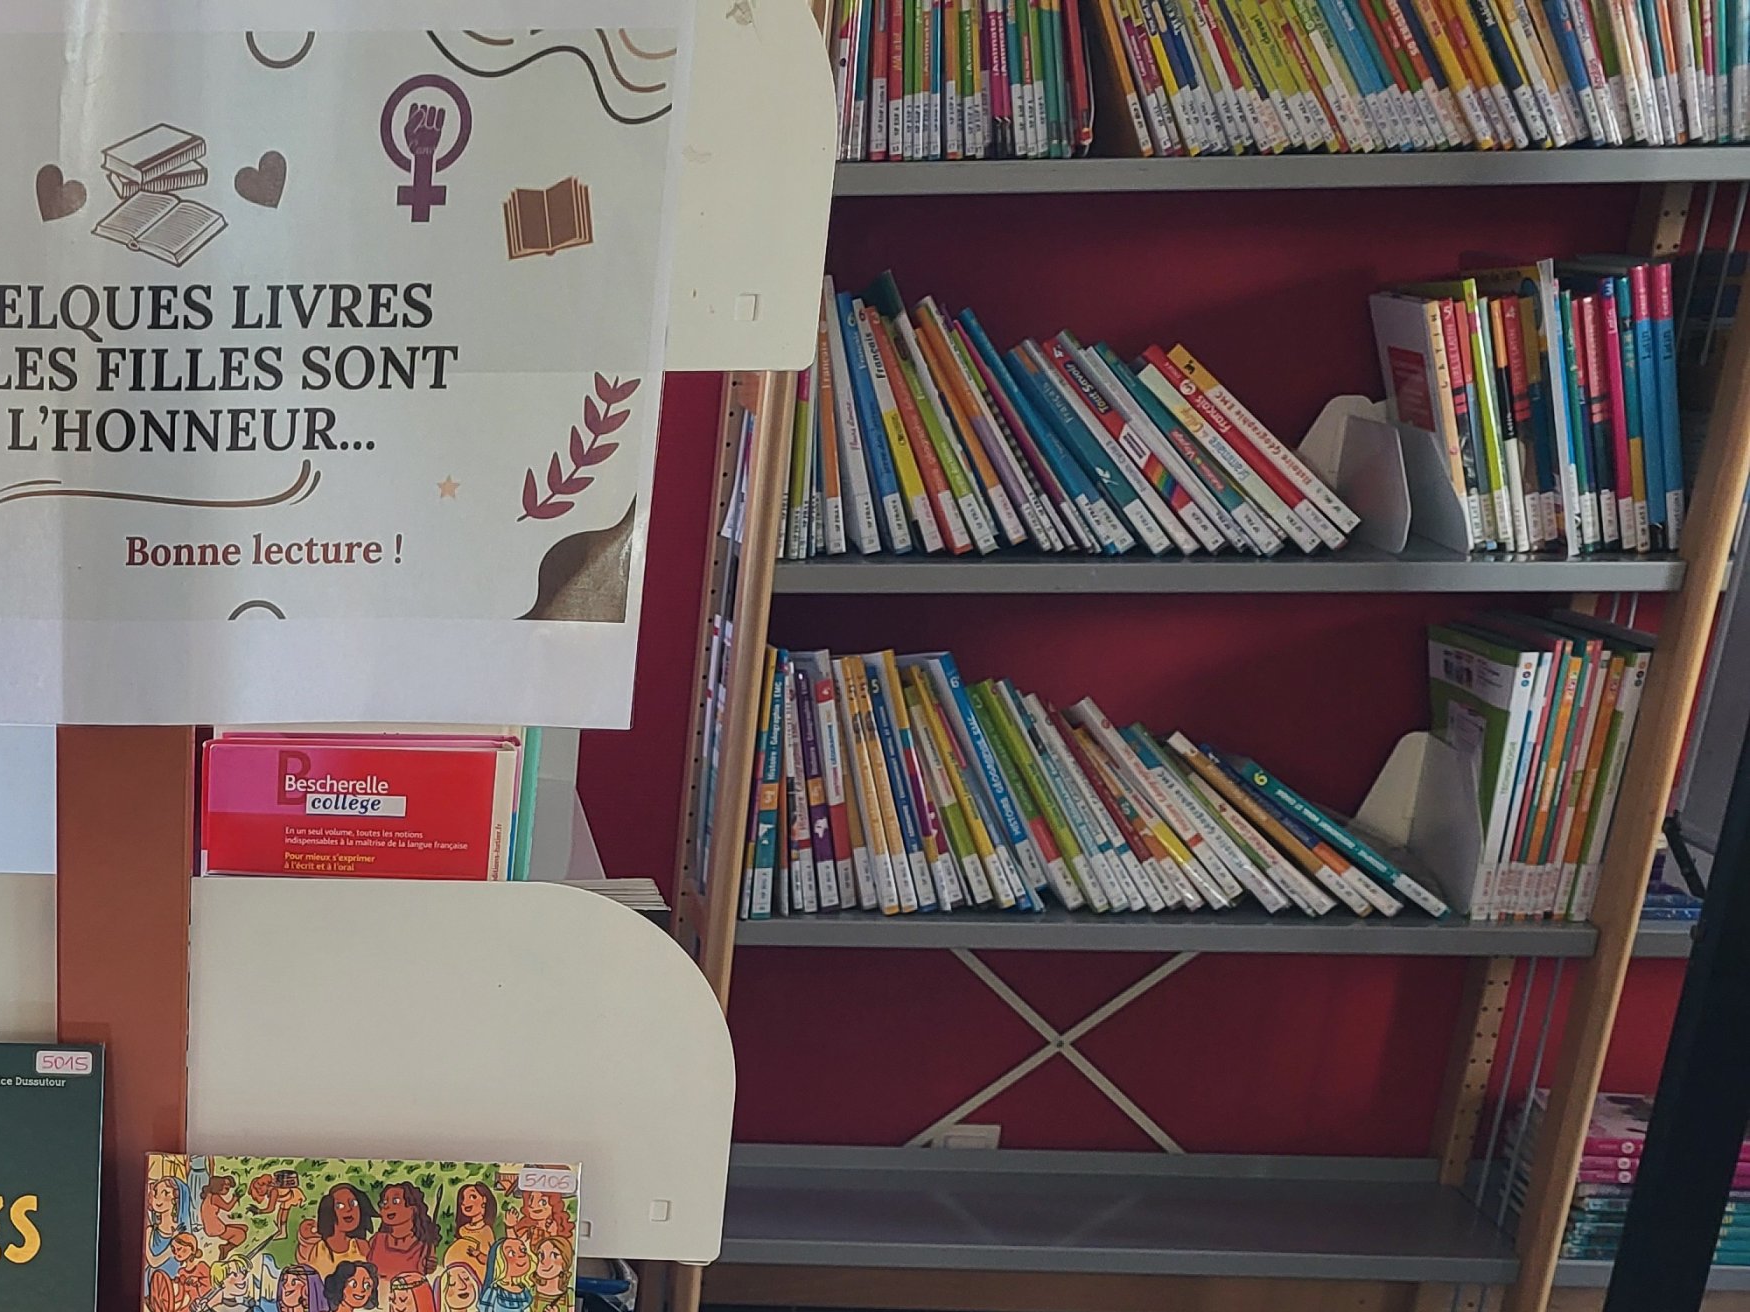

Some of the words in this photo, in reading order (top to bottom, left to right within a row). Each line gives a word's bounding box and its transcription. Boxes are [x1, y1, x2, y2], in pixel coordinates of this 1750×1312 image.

[232, 282, 434, 331] LIVRES
[95, 345, 286, 392] FILLES
[301, 344, 459, 391] SONT
[125, 535, 242, 567] Bonne
[252, 534, 383, 569] lecture
[393, 534, 404, 565] !
[285, 775, 389, 794] Bescherelle
[311, 794, 381, 813] collège
[285, 852, 303, 860] Pour
[306, 853, 331, 861] mieux
[332, 854, 375, 863] s'exprimer
[42, 1055, 89, 1072] 5015
[14, 1076, 66, 1088] Dussutour
